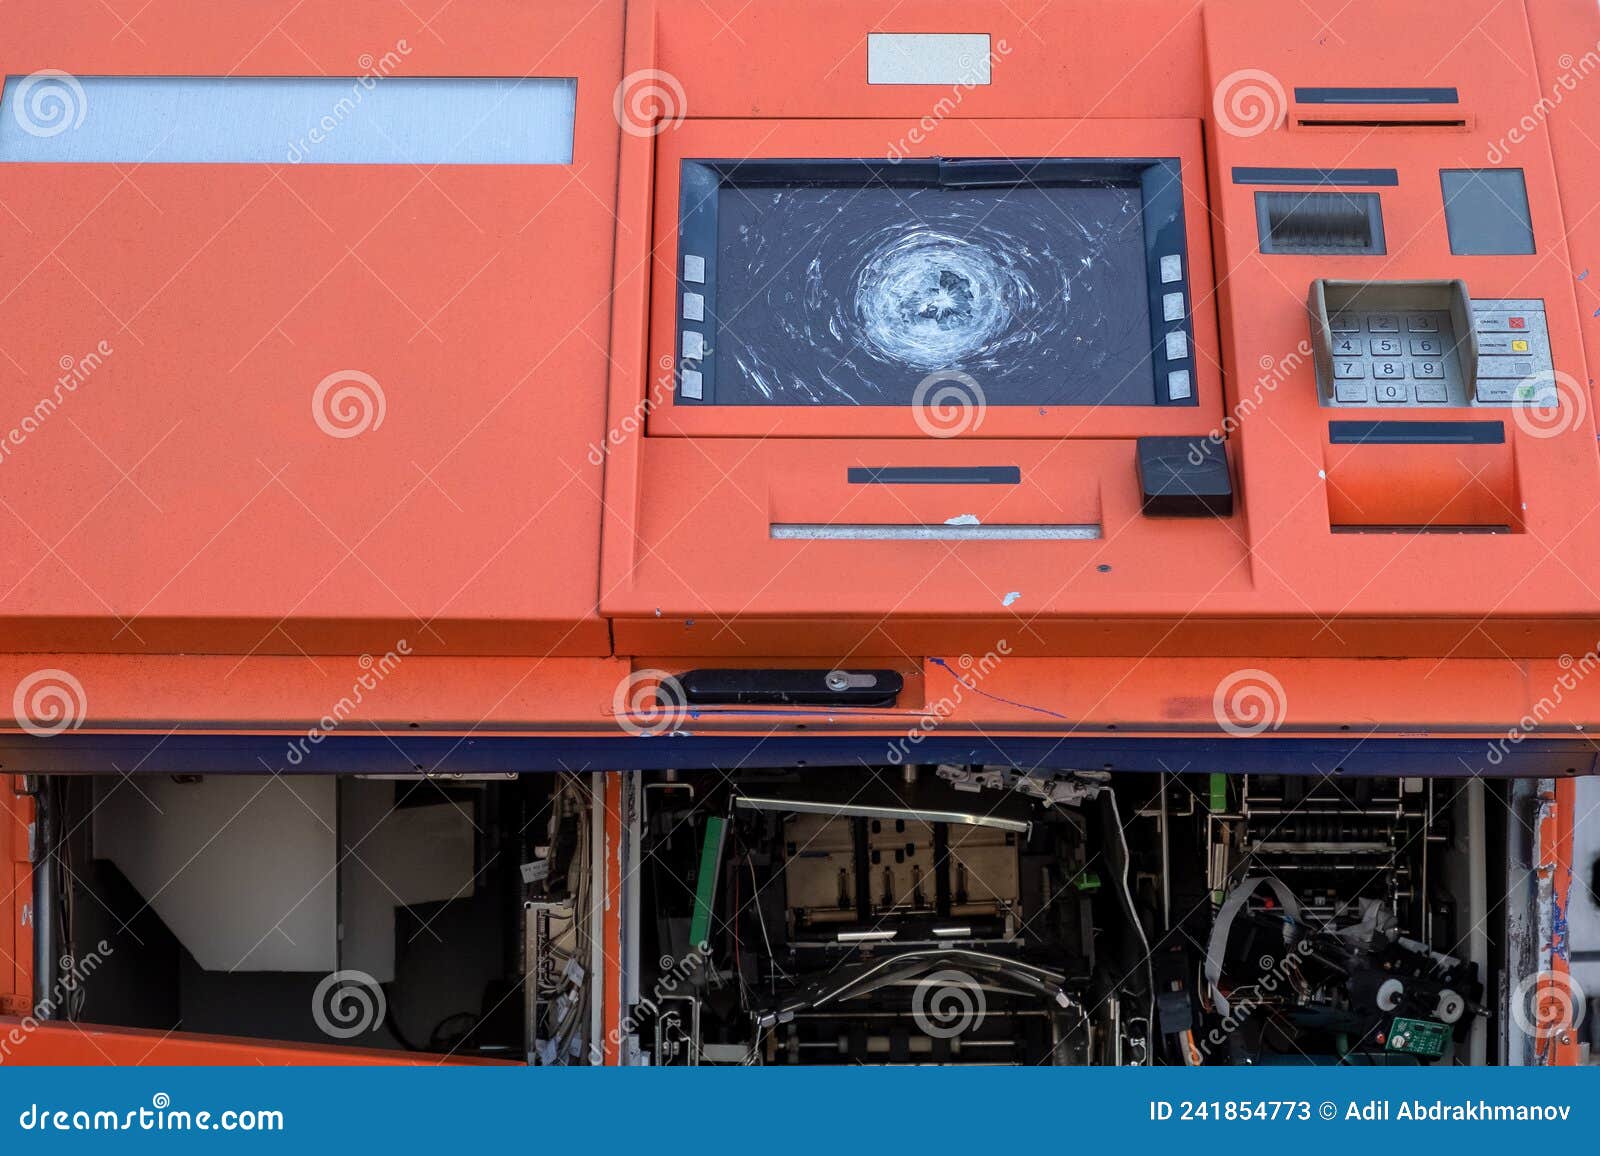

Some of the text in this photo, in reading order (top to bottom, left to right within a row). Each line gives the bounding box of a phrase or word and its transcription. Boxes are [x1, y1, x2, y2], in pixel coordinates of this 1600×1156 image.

[1379, 317, 1390, 328] 2
[1419, 317, 1430, 328] 3
[1341, 340, 1432, 351] 4 5 6
[1343, 363, 1434, 374] 7 8 9
[1386, 386, 1396, 397] 0
